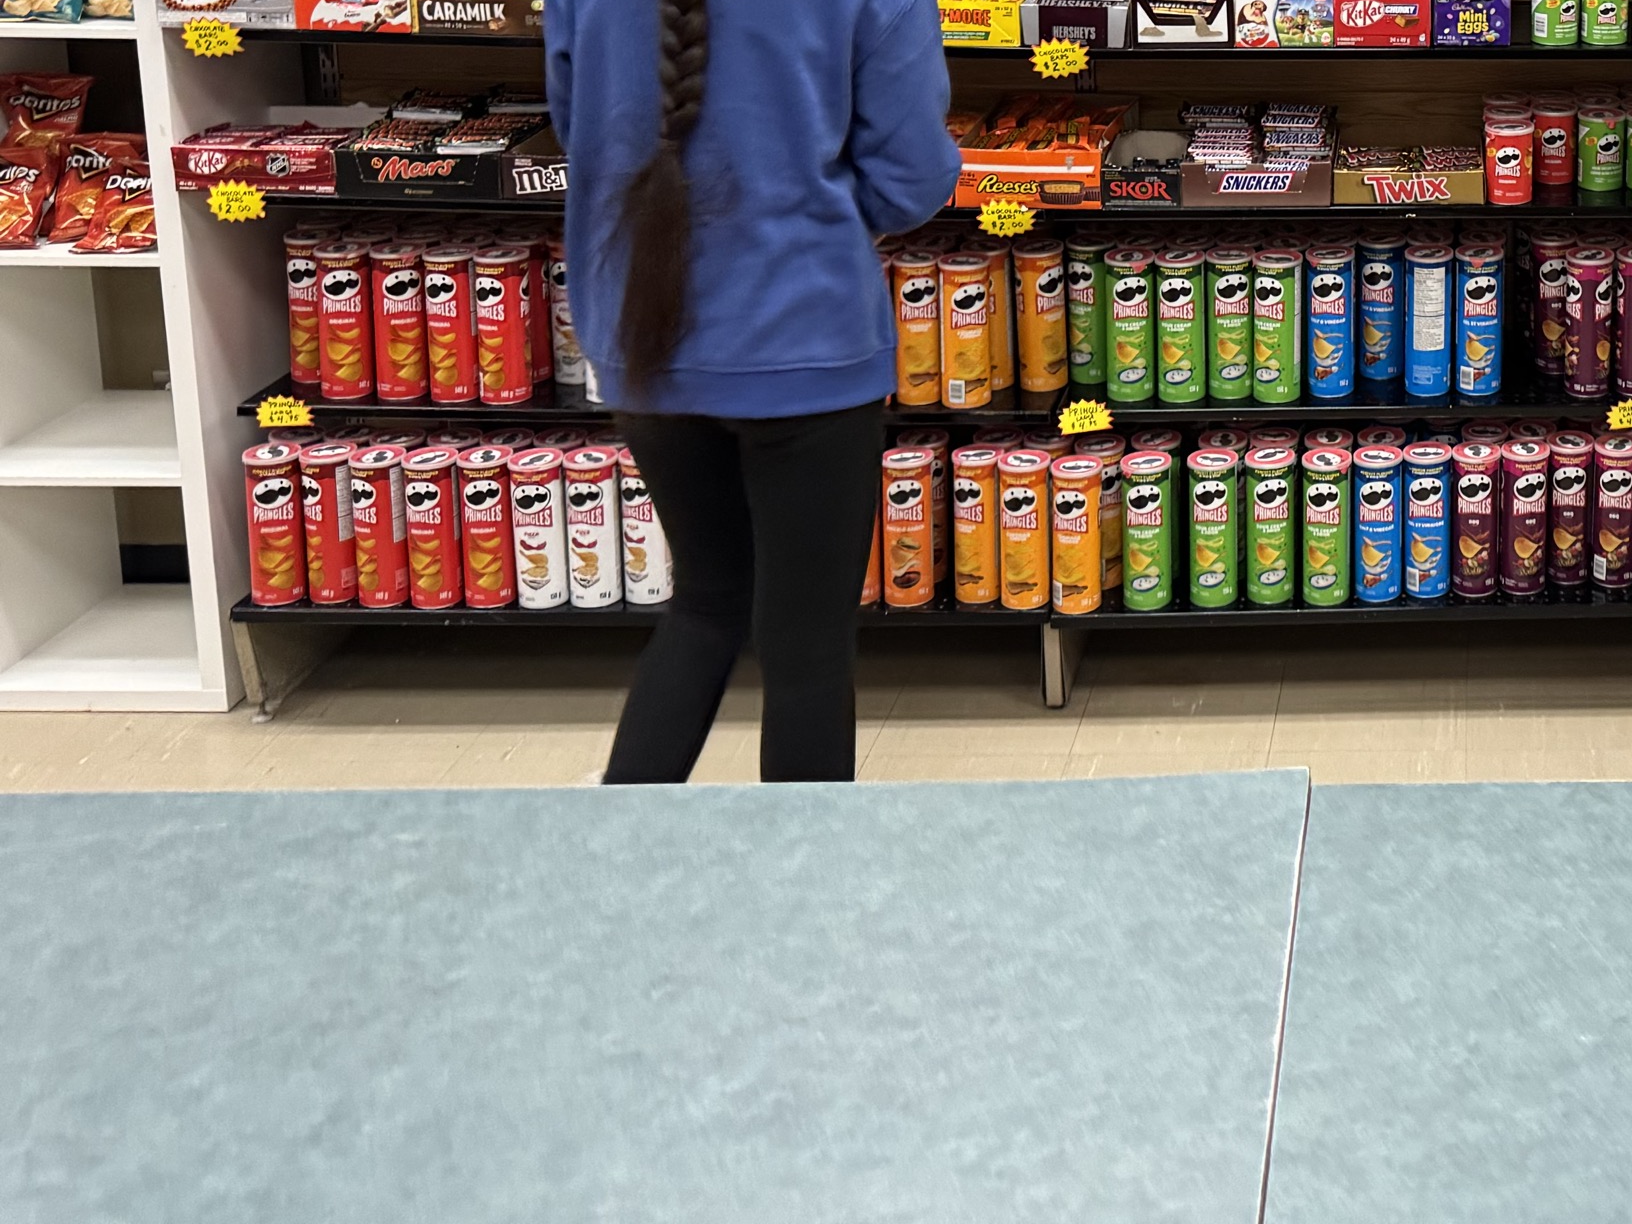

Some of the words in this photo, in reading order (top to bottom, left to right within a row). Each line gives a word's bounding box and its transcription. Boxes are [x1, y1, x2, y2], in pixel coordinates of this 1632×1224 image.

[422, 0, 506, 23] CARAMILK
[1458, 9, 1487, 23] Mini
[1052, 25, 1097, 40] HERSHEY'S
[1457, 20, 1489, 35] Eggs
[195, 39, 229, 52] $2.00
[1044, 60, 1078, 73] $2.00
[1595, 152, 1621, 165] PRINGLES
[378, 155, 456, 183] Mars
[976, 173, 1041, 195] Reese's
[1109, 181, 1172, 201] SKOR
[1222, 174, 1290, 192] SNICKERS
[1364, 174, 1452, 204] Twix
[992, 221, 1024, 232] $2.00
[323, 295, 362, 314] PRINGLES
[901, 303, 938, 322] PRINGLES
[1159, 302, 1195, 320] PRINGLES
[1553, 491, 1586, 509] PRINGLES
[464, 506, 503, 525] PRINGLES
[1254, 504, 1289, 522] PRINGLES
[1409, 502, 1443, 519] PRINGLES
[1002, 513, 1038, 531] PRINGLES
